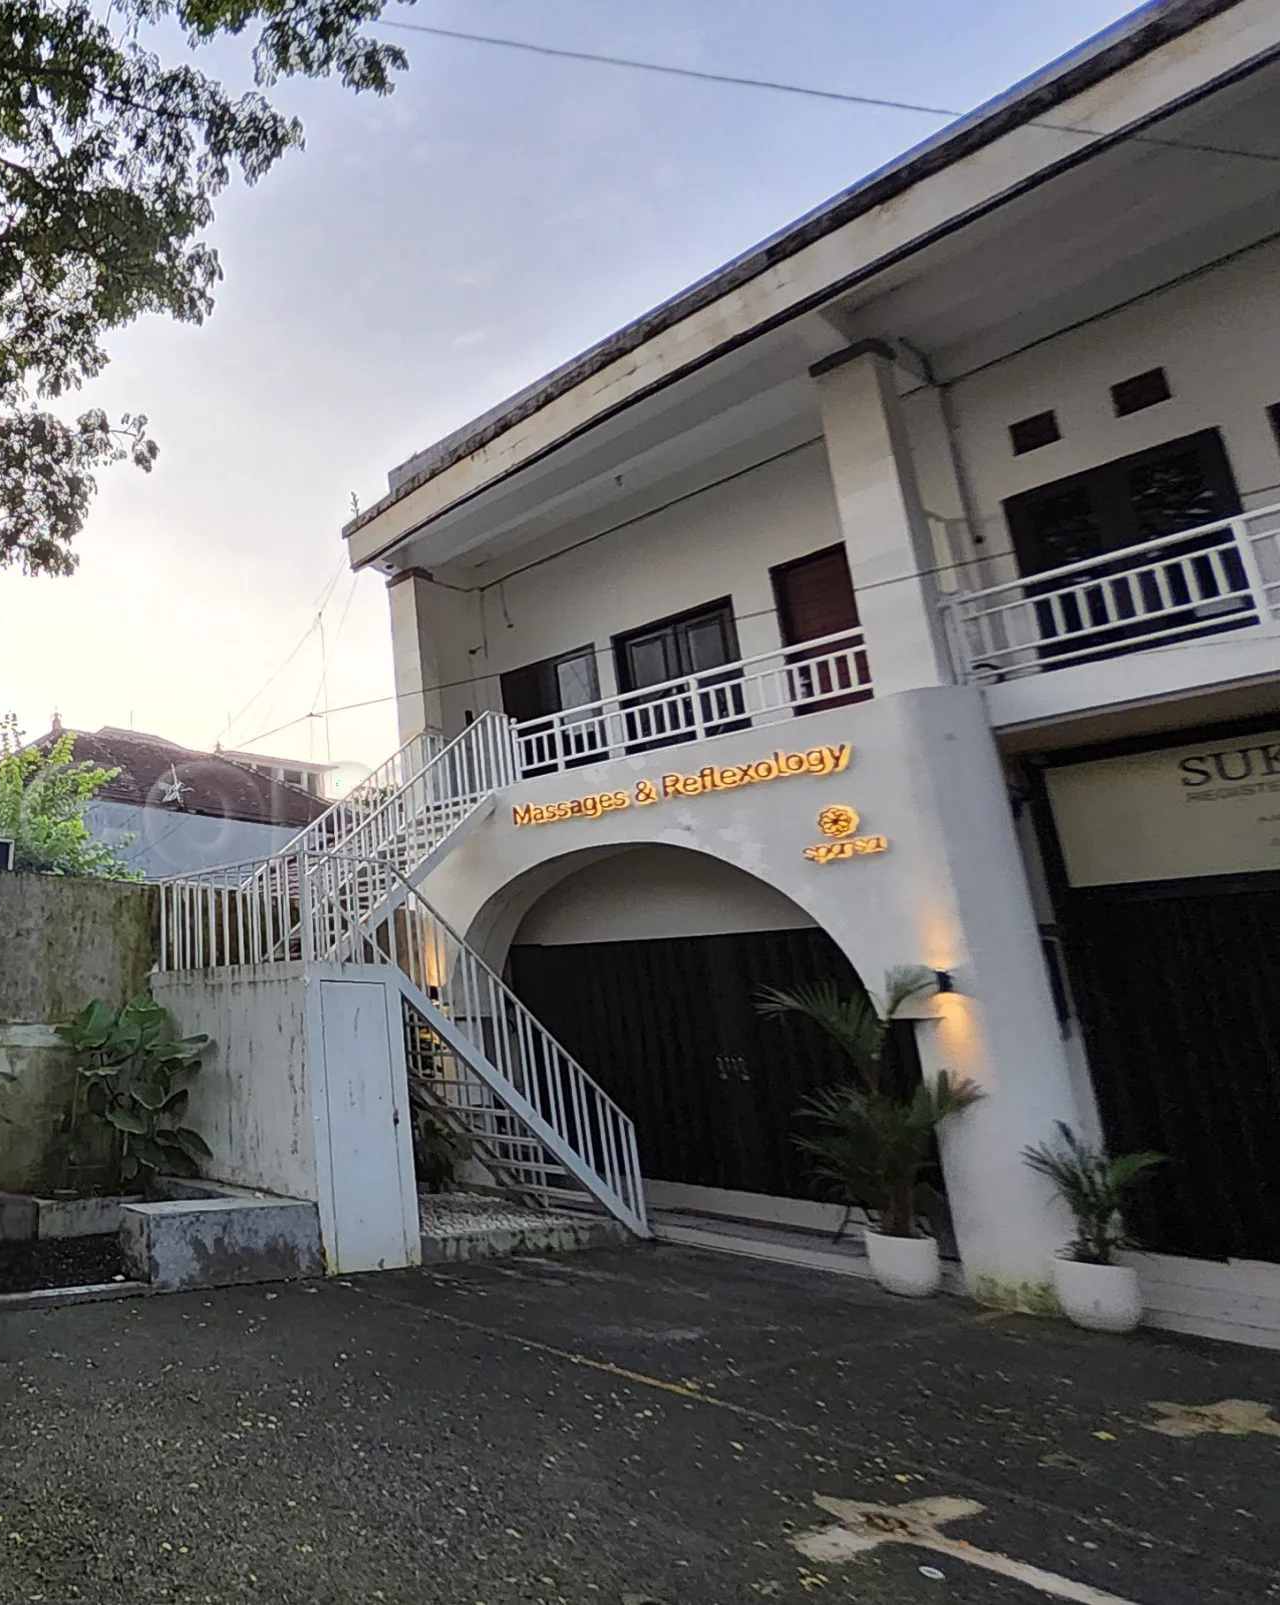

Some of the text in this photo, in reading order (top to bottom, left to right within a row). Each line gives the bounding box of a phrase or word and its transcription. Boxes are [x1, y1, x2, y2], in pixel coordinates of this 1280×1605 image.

[512, 741, 853, 827] Massages & Reflexology
[802, 834, 888, 864] sparsa
